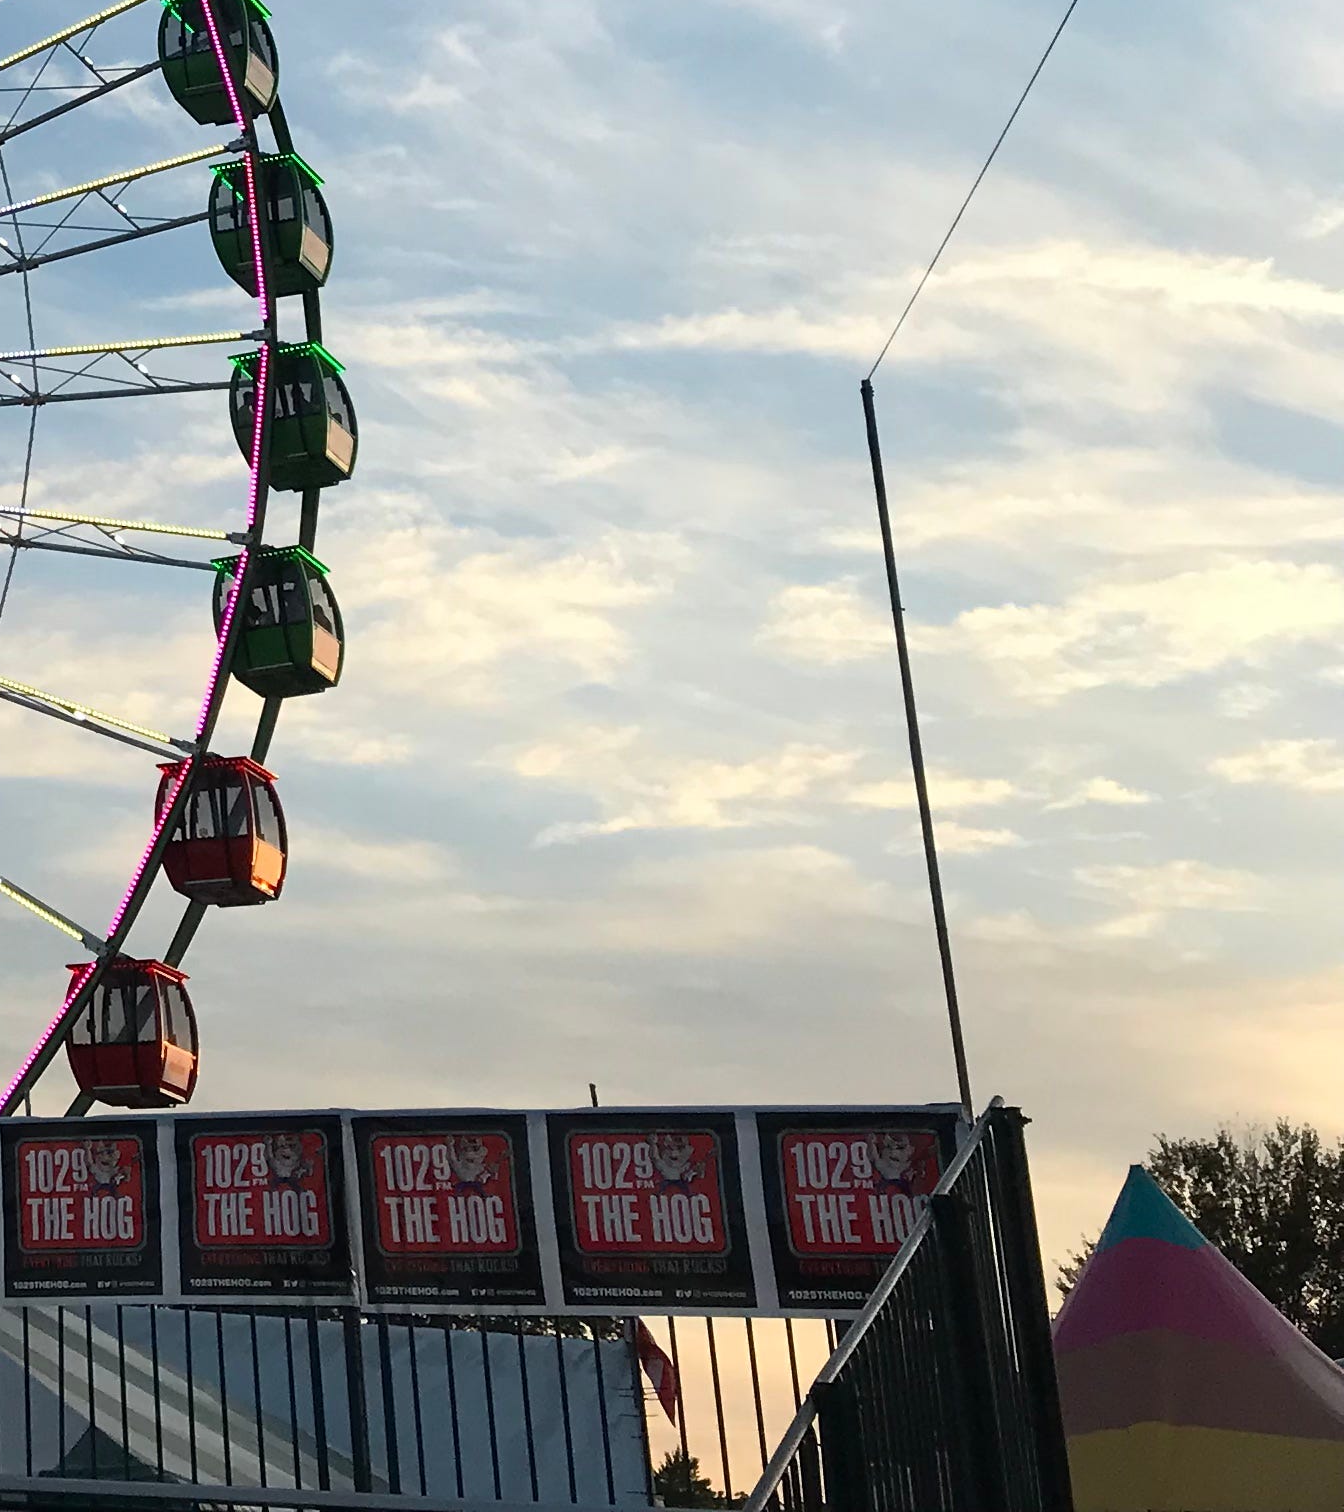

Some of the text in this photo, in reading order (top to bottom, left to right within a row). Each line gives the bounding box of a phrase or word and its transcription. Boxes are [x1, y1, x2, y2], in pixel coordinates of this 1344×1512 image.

[25, 1148, 88, 1193] 1029
[201, 1143, 269, 1188] 1029
[380, 1144, 452, 1192] 1029
[577, 1143, 655, 1190] 1029 FM
[791, 1141, 873, 1189] 1029 FM
[26, 1196, 134, 1241] THE HOG
[203, 1190, 320, 1237] THE HOG
[384, 1195, 507, 1244] THE HOG
[581, 1193, 715, 1244] THE HOG
[795, 1194, 862, 1243] THE
